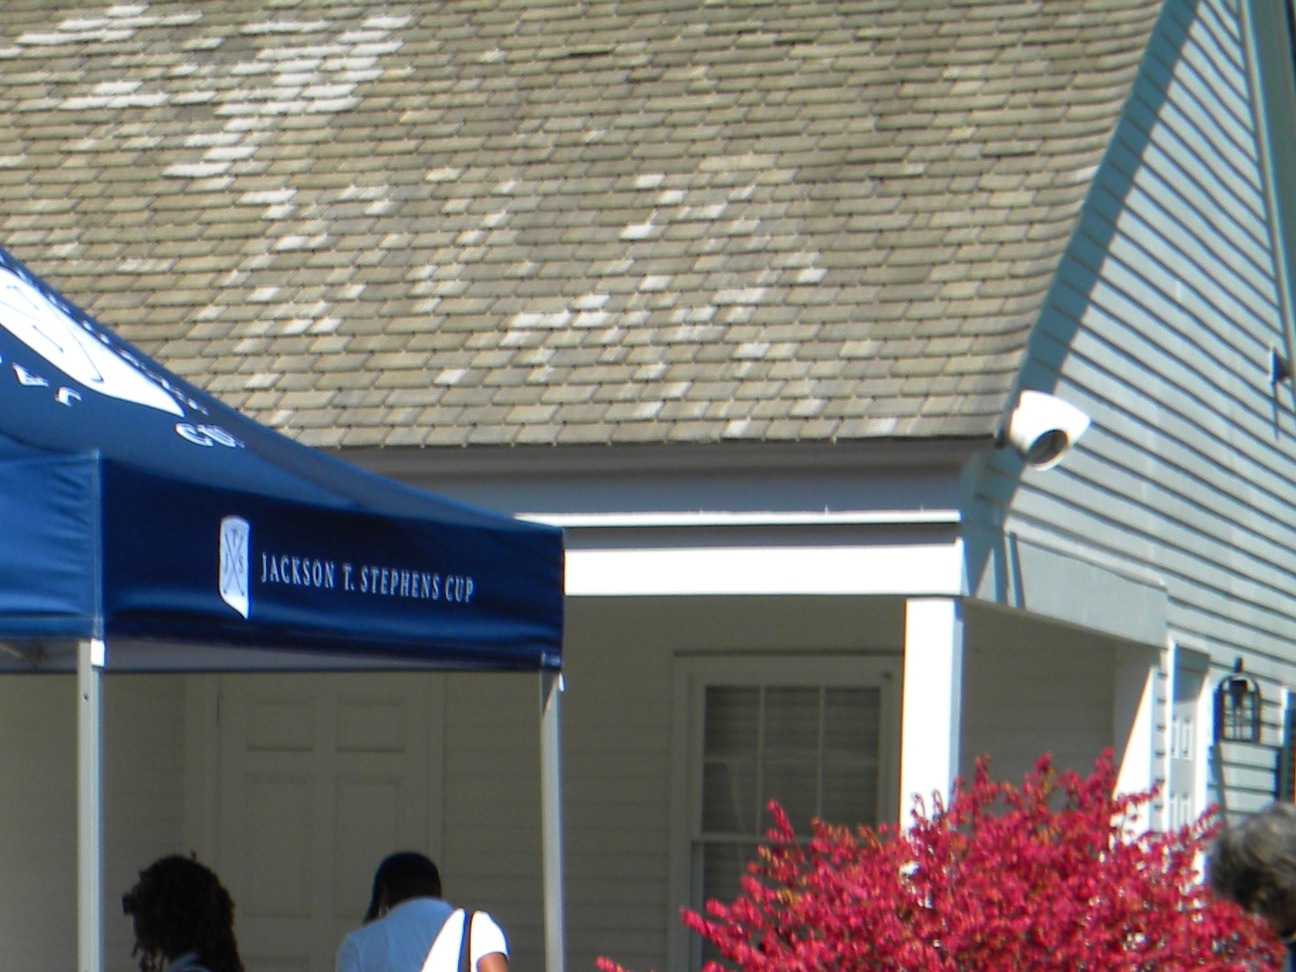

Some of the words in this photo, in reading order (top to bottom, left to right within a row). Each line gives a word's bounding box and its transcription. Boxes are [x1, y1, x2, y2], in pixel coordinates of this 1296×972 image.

[261, 552, 334, 590] JACKSON
[342, 562, 355, 591] T.
[360, 564, 440, 600] STEPHENS
[445, 574, 473, 603] CUP
